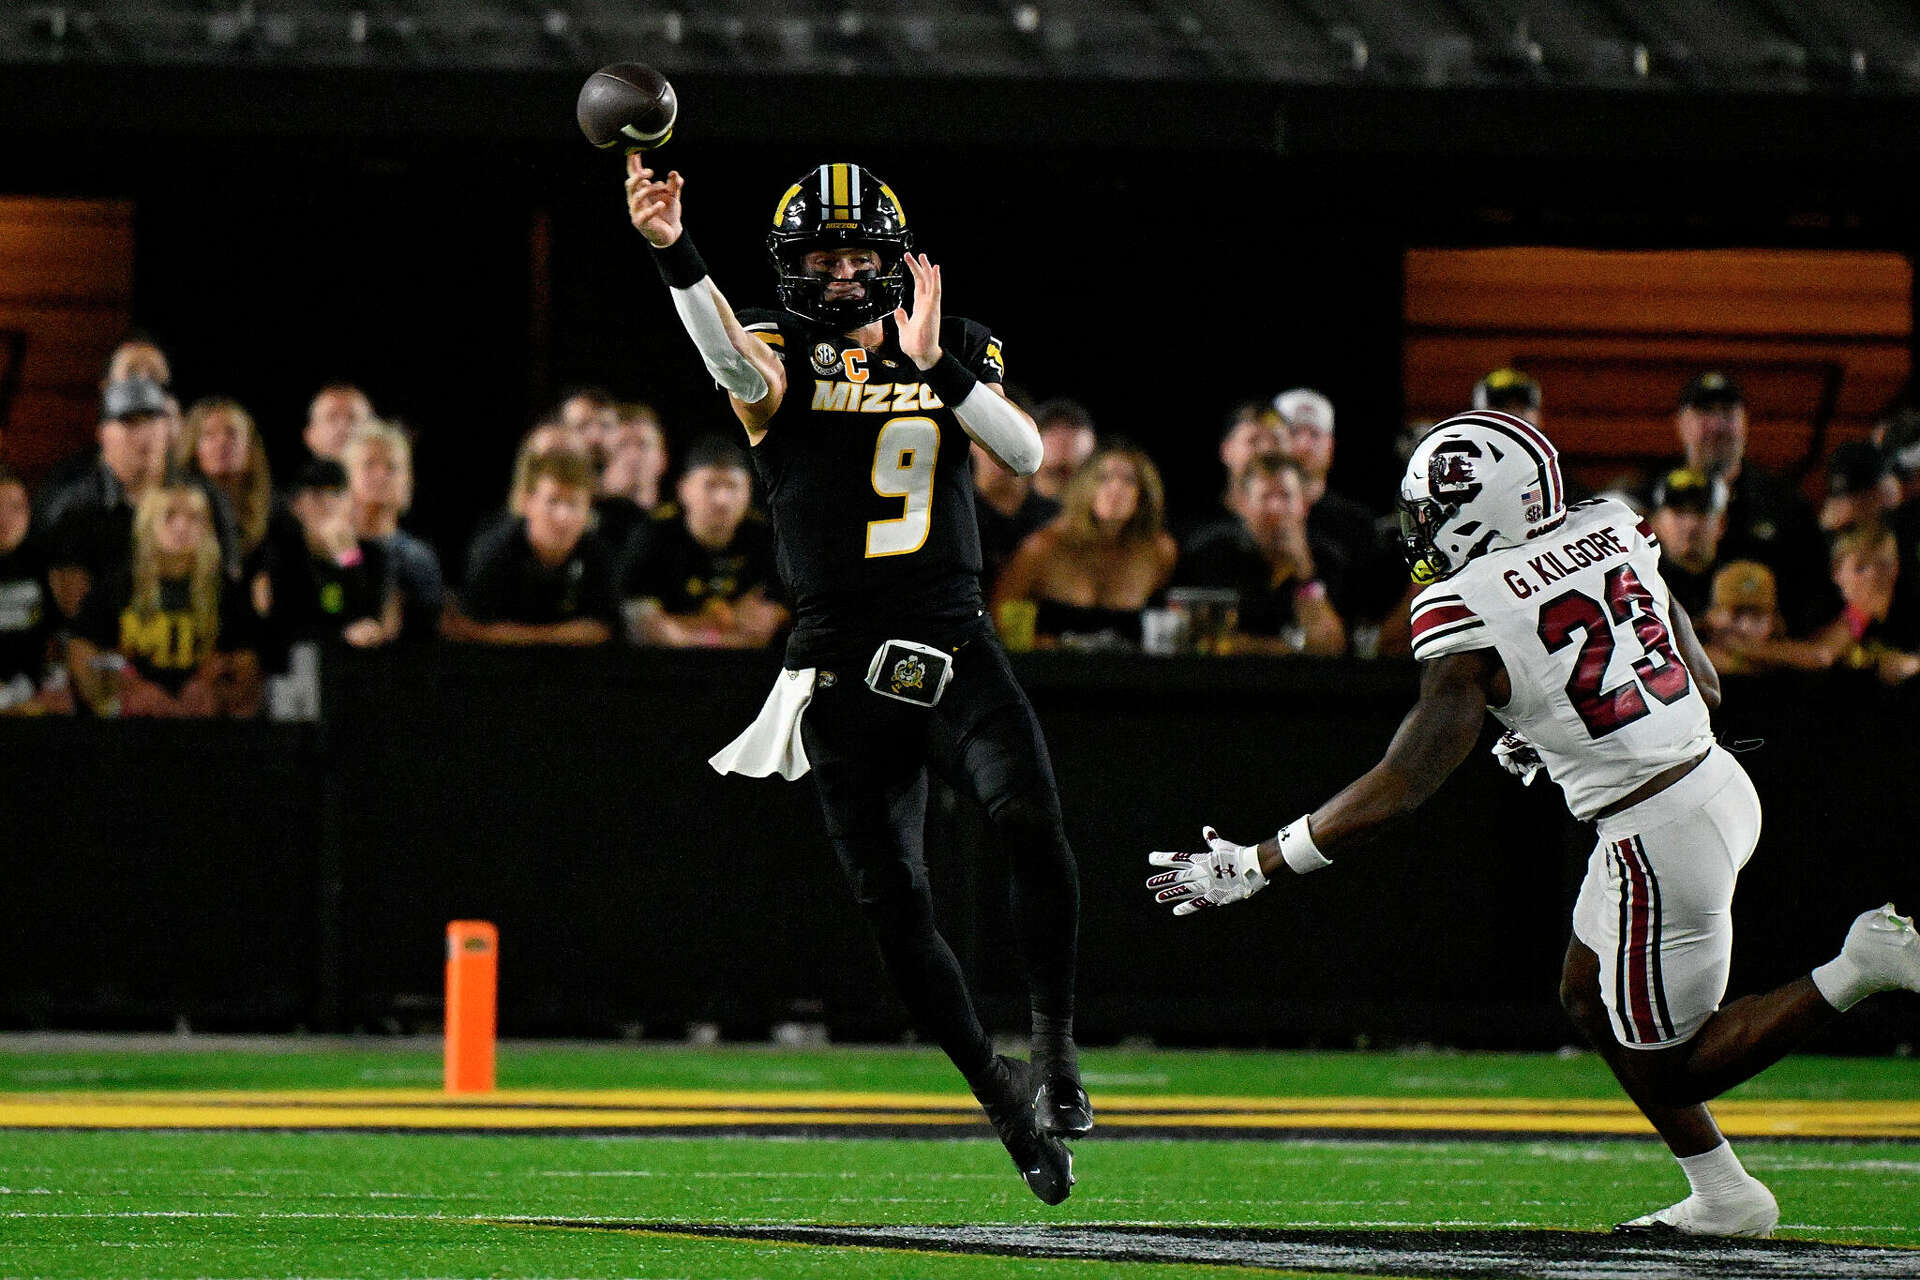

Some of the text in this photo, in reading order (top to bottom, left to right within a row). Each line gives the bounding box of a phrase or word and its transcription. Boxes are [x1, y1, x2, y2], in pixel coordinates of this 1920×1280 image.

[811, 380, 945, 413] MIZZO
[841, 348, 870, 383] C
[865, 416, 941, 558] 9
[1503, 526, 1629, 599] G. KILGORE
[1537, 563, 1690, 740] 23
